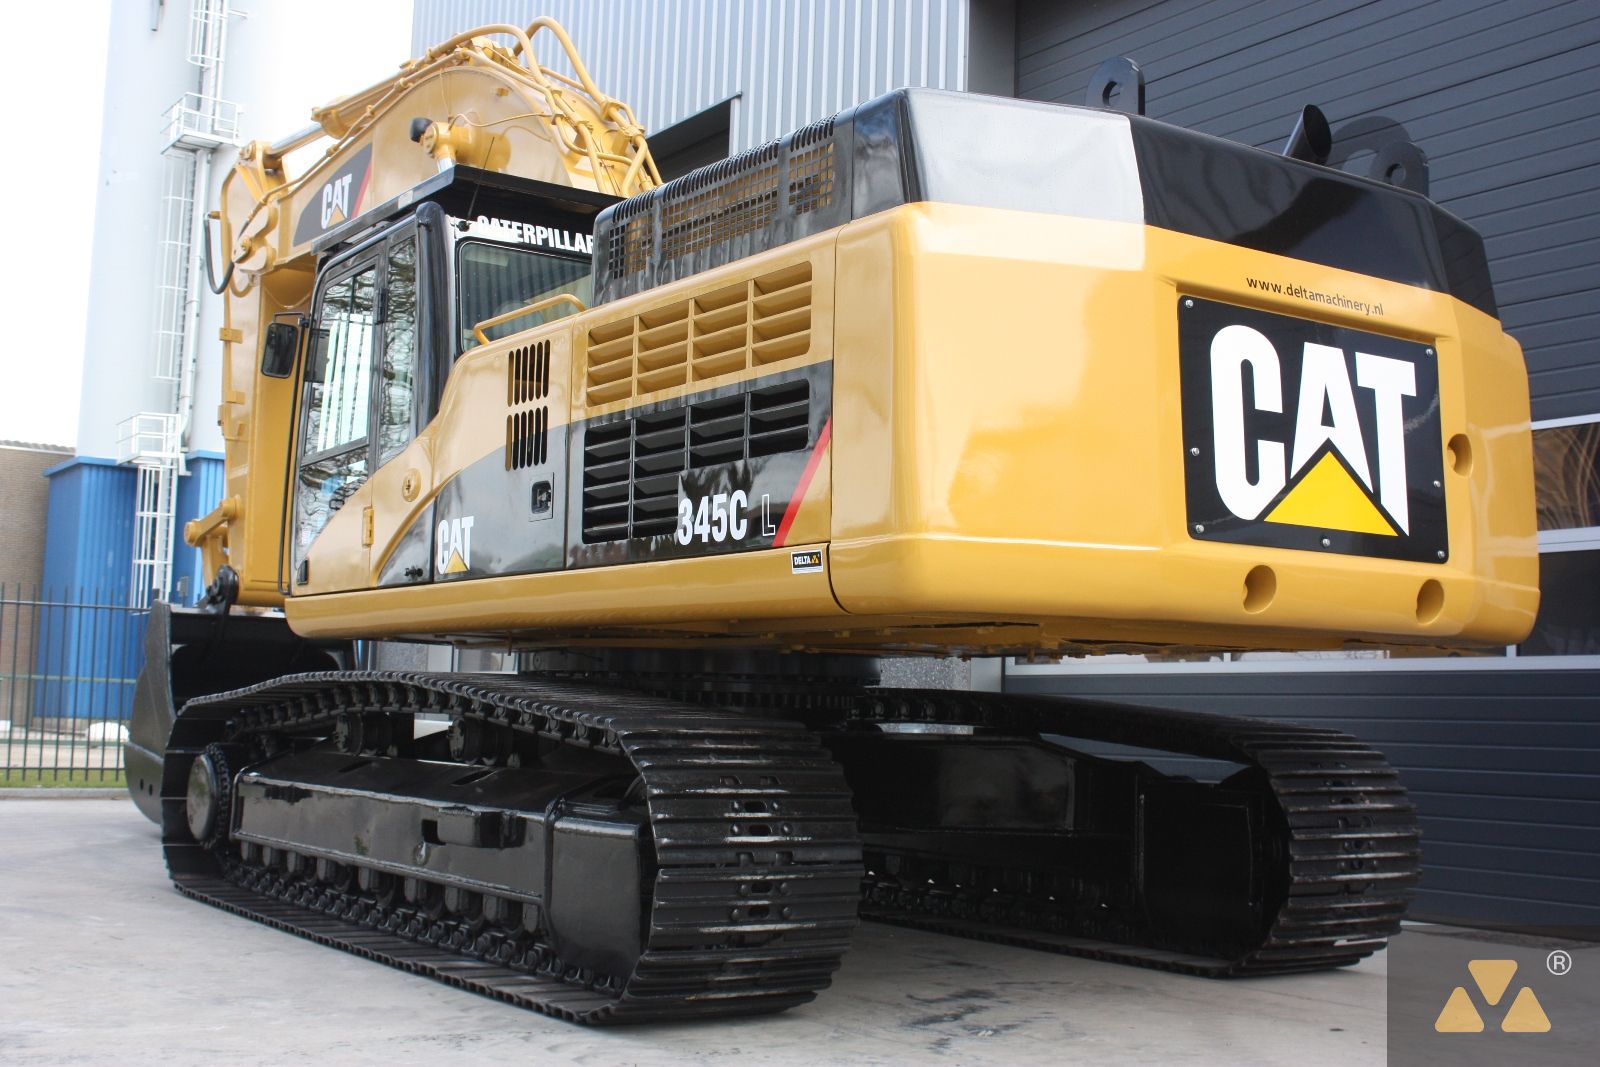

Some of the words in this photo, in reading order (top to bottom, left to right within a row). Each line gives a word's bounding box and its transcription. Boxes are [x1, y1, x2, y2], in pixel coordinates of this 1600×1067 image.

[321, 173, 353, 230] CAT
[1246, 277, 1384, 316] www.deltamachinery.nl
[1210, 324, 1417, 537] CAT
[437, 516, 474, 575] CAT
[677, 489, 748, 546] 345C
[761, 493, 776, 537] L
[793, 555, 811, 566] DELTA
